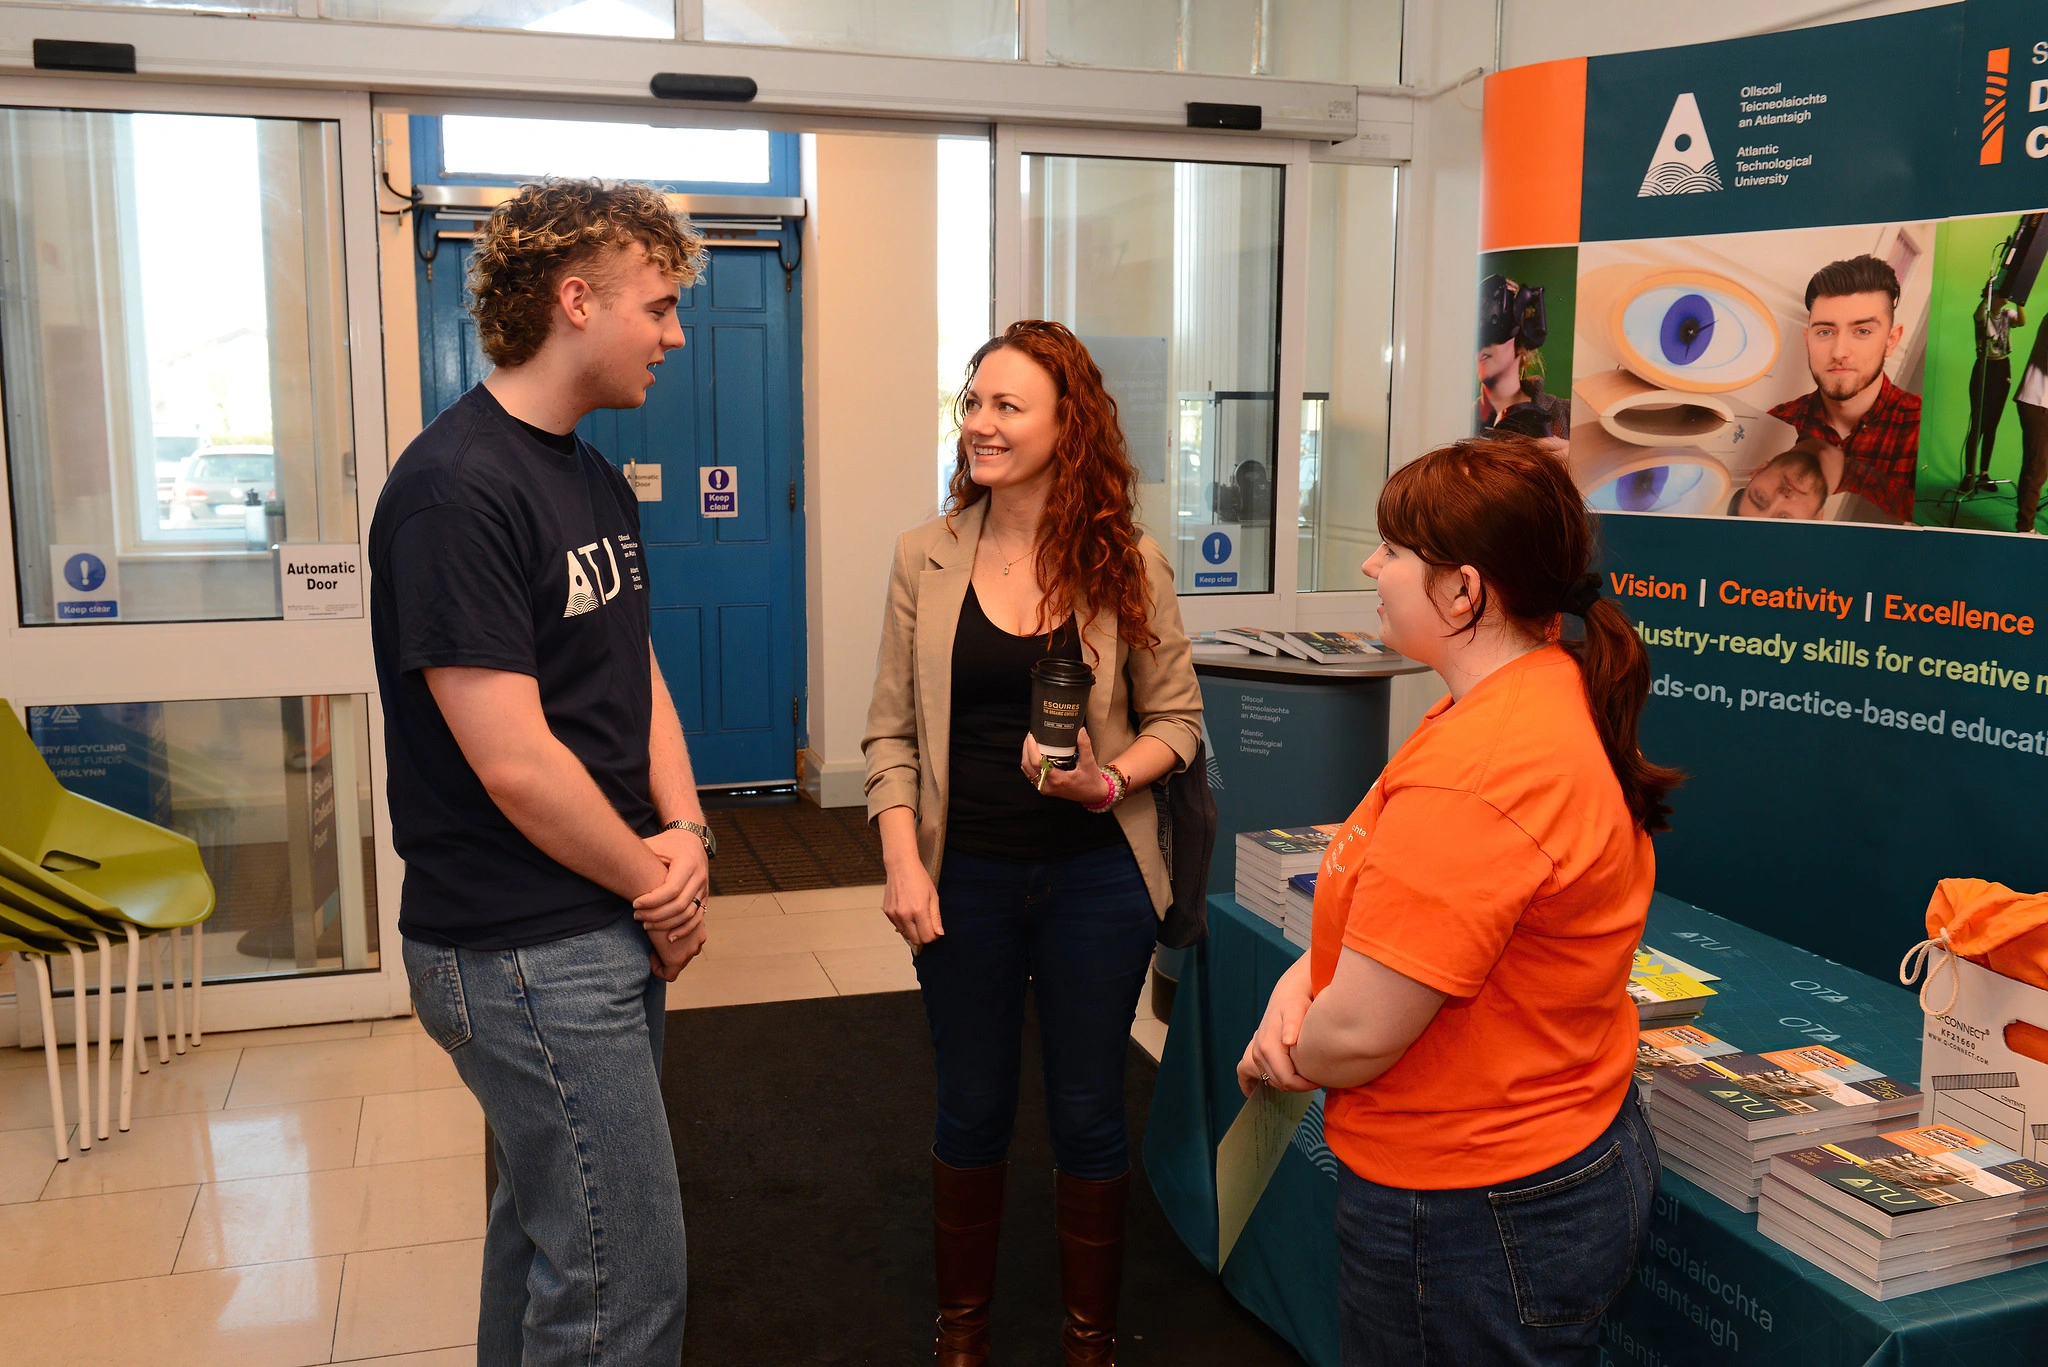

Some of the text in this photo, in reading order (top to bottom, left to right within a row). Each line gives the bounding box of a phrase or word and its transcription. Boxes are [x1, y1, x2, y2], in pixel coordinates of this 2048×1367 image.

[1740, 82, 1782, 98] Ollscoil
[1738, 109, 1812, 128] an Atlantaigh
[1736, 144, 1779, 158] Atlantic
[1736, 154, 1813, 173] Technological
[1734, 173, 1789, 188] University
[709, 494, 730, 503] Keep
[709, 503, 730, 511] clear
[287, 561, 356, 575] Automatic
[306, 578, 338, 590] Door
[563, 537, 621, 618] ATU
[1199, 575, 1233, 584] Keep clear
[63, 605, 111, 615] Keep clear
[1609, 572, 2035, 635] Vision Creativity Excellence
[1803, 637, 1870, 668] skills
[1875, 645, 1914, 674] for
[1918, 660, 2030, 692] creative
[1043, 700, 1080, 710] ESQUIRES
[1241, 695, 1264, 704] Ollscoil
[1740, 687, 1946, 735] practice-based
[63, 743, 127, 754] RECYCLING
[1240, 737, 1283, 748] Technological
[1240, 745, 1270, 756] University
[84, 755, 123, 765] FUNDS
[1671, 932, 1732, 951] ATU
[1655, 976, 1683, 988] 25
[1789, 980, 1850, 1004] OTA
[1778, 1017, 1842, 1042] OTA
[1941, 1027, 1976, 1050] KF21660
[1709, 1090, 1776, 1114] ATU
[2001, 1094, 2026, 1110] CONTENTS
[1838, 1178, 1918, 1205] ATU
[1597, 1311, 1670, 1367] Atlanti
